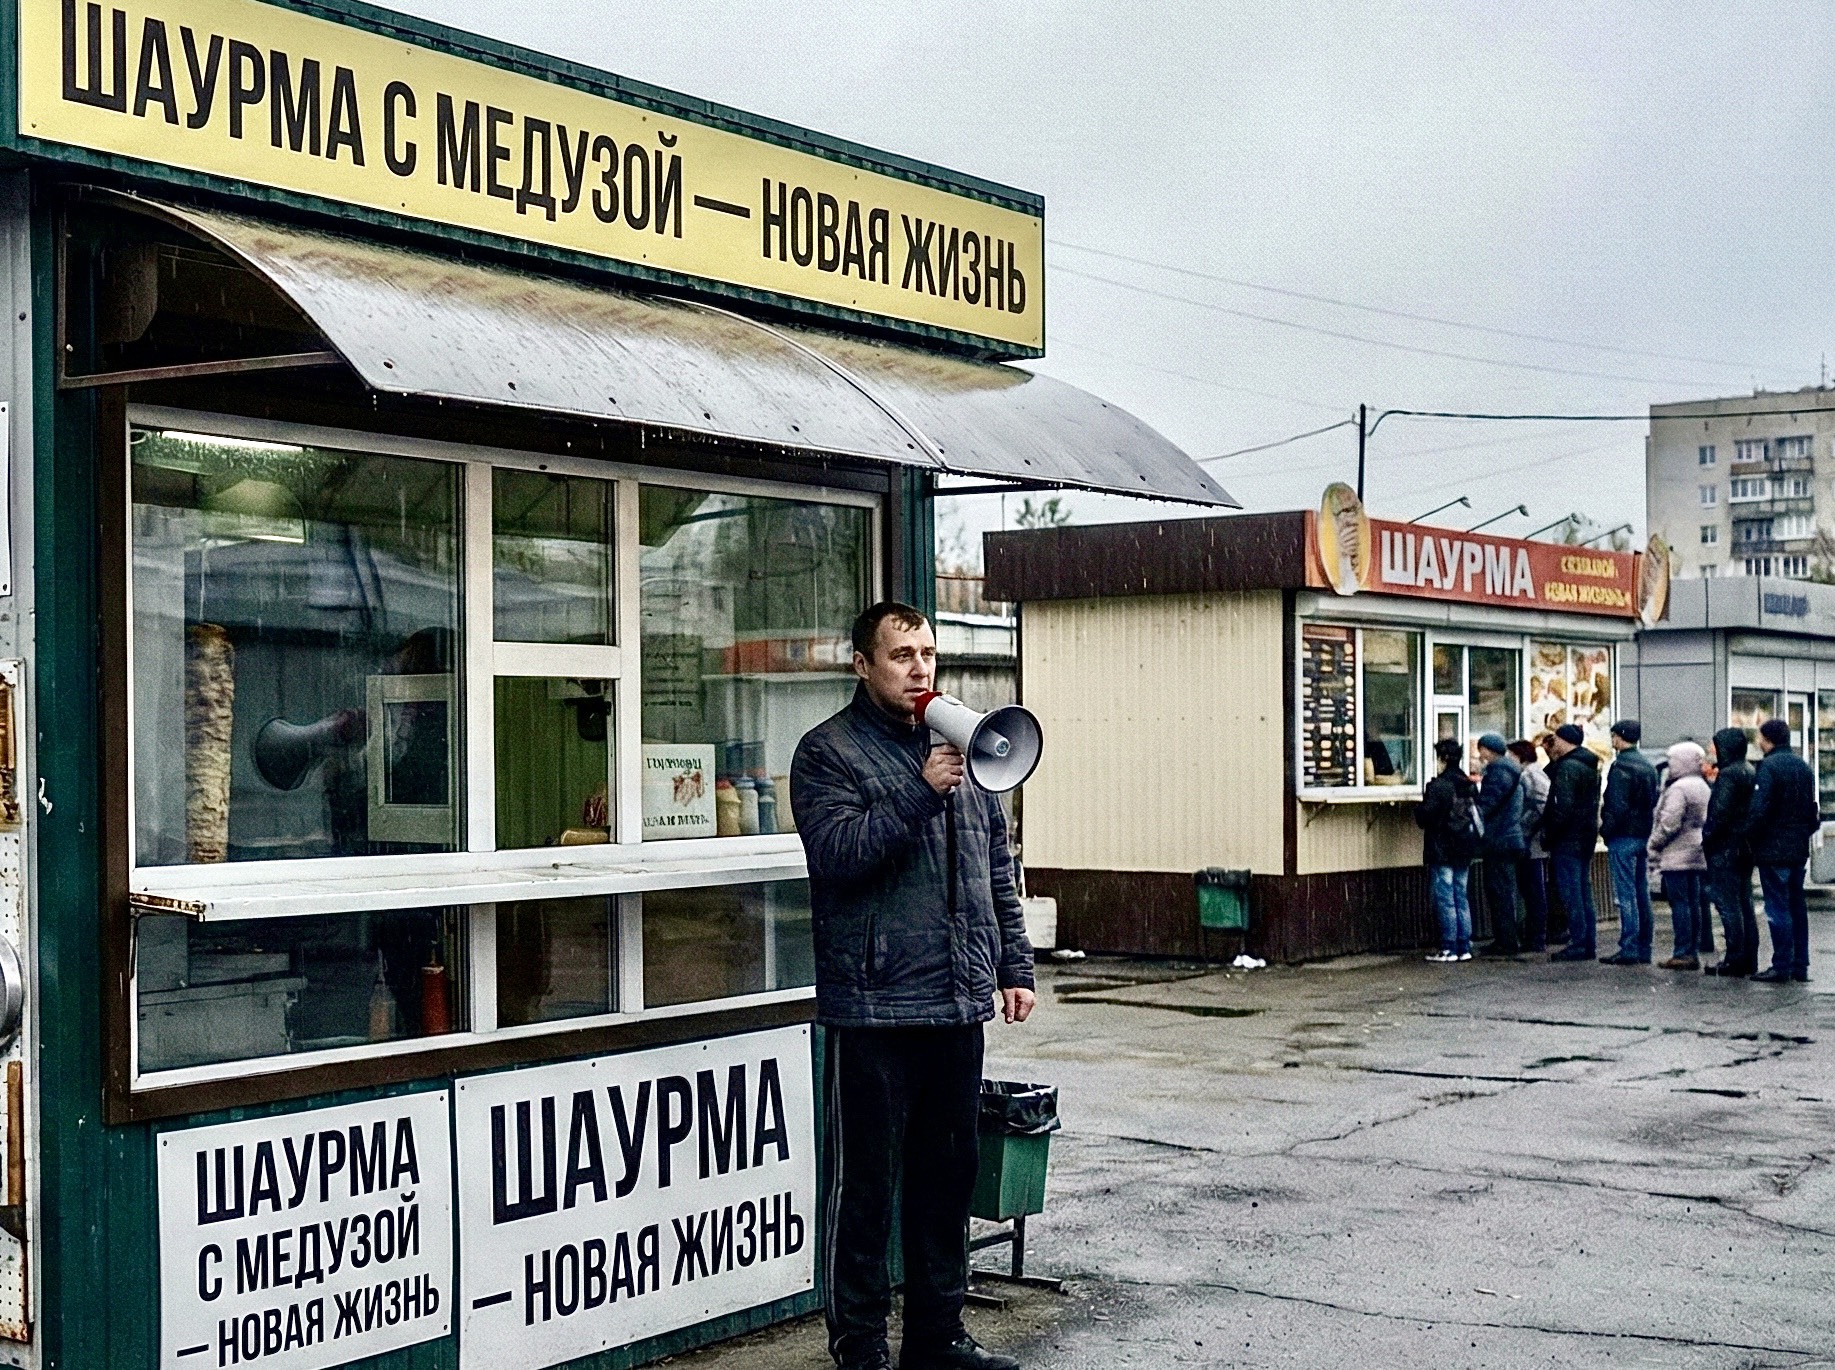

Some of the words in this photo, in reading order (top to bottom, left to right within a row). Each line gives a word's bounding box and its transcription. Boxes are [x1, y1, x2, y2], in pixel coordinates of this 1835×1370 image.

[62, 0, 365, 166] ШАУРМА
[384, 81, 416, 176] С
[437, 92, 682, 239] МЕДУЗОЙ
[763, 178, 889, 284] НОВАЯ
[901, 214, 1026, 314] ЖИЗНЬ
[1382, 530, 1536, 599] ШАУРМА
[197, 1117, 420, 1225] ШАУРМА
[491, 1058, 790, 1225] ШАУРМА
[199, 1244, 223, 1301] С
[237, 1191, 420, 1294] МЕДУЗОЙ
[525, 1224, 659, 1327] НОВАЯ
[672, 1191, 805, 1285] ЖИЗНЬ
[219, 1298, 324, 1368] НОВАЯ
[334, 1273, 440, 1339] ЖИЗНЬ
